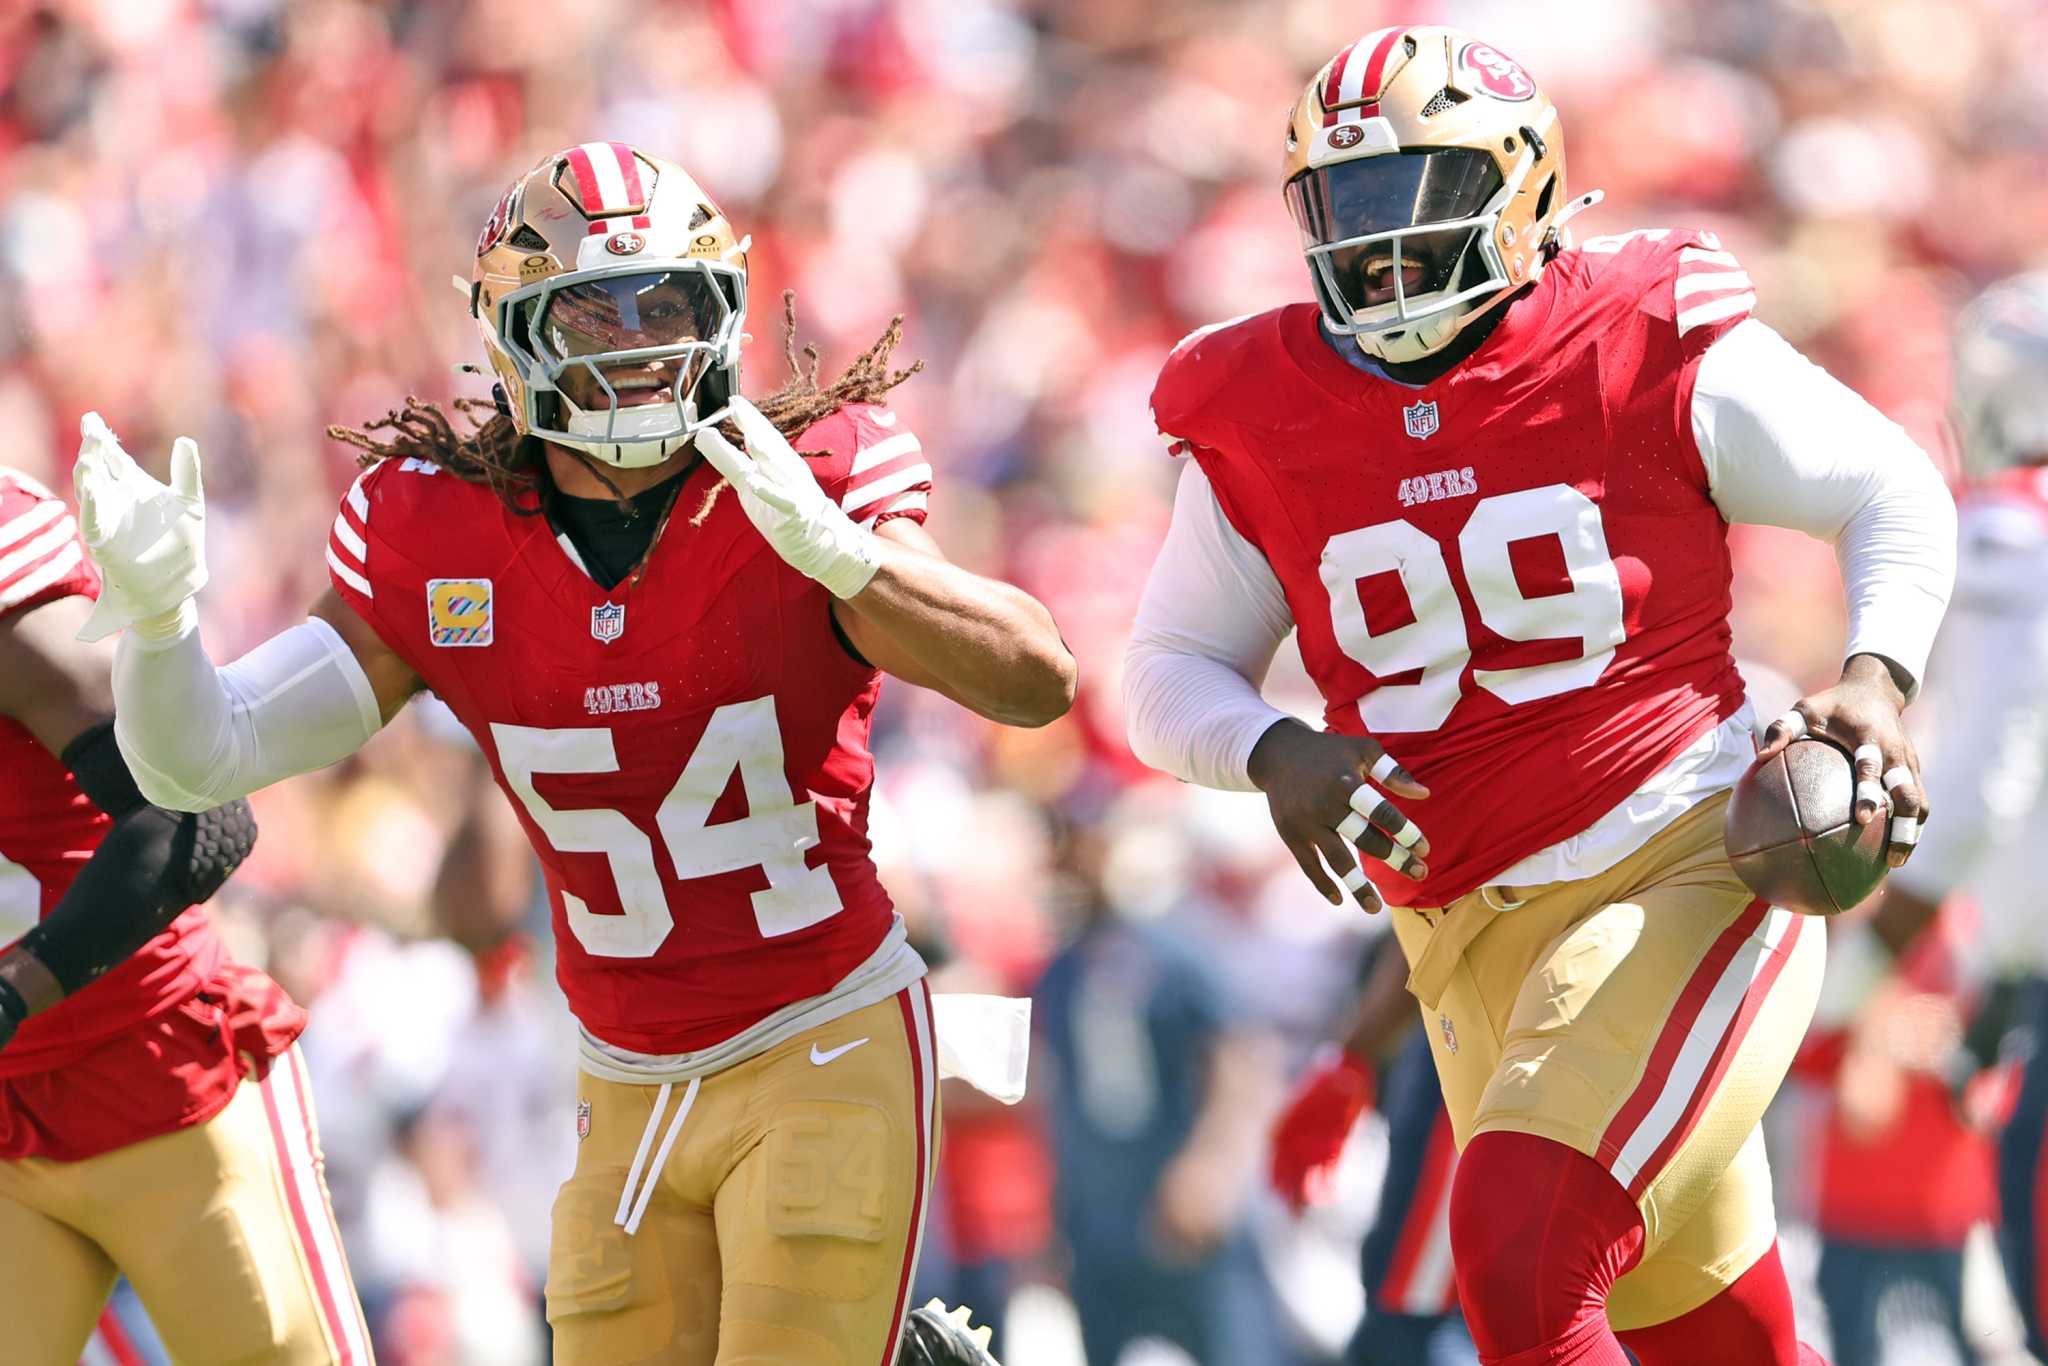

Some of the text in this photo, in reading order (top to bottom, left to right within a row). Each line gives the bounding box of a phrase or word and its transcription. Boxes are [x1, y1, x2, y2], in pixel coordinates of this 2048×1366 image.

[519, 265, 556, 276] OAKLEY
[1411, 416, 1434, 433] NFL
[1398, 466, 1478, 508] 49ERS
[433, 583, 491, 629] C
[1318, 483, 1627, 734] 99
[596, 619, 619, 635] NFL
[583, 680, 661, 715] 49ERS
[489, 693, 845, 958] 54
